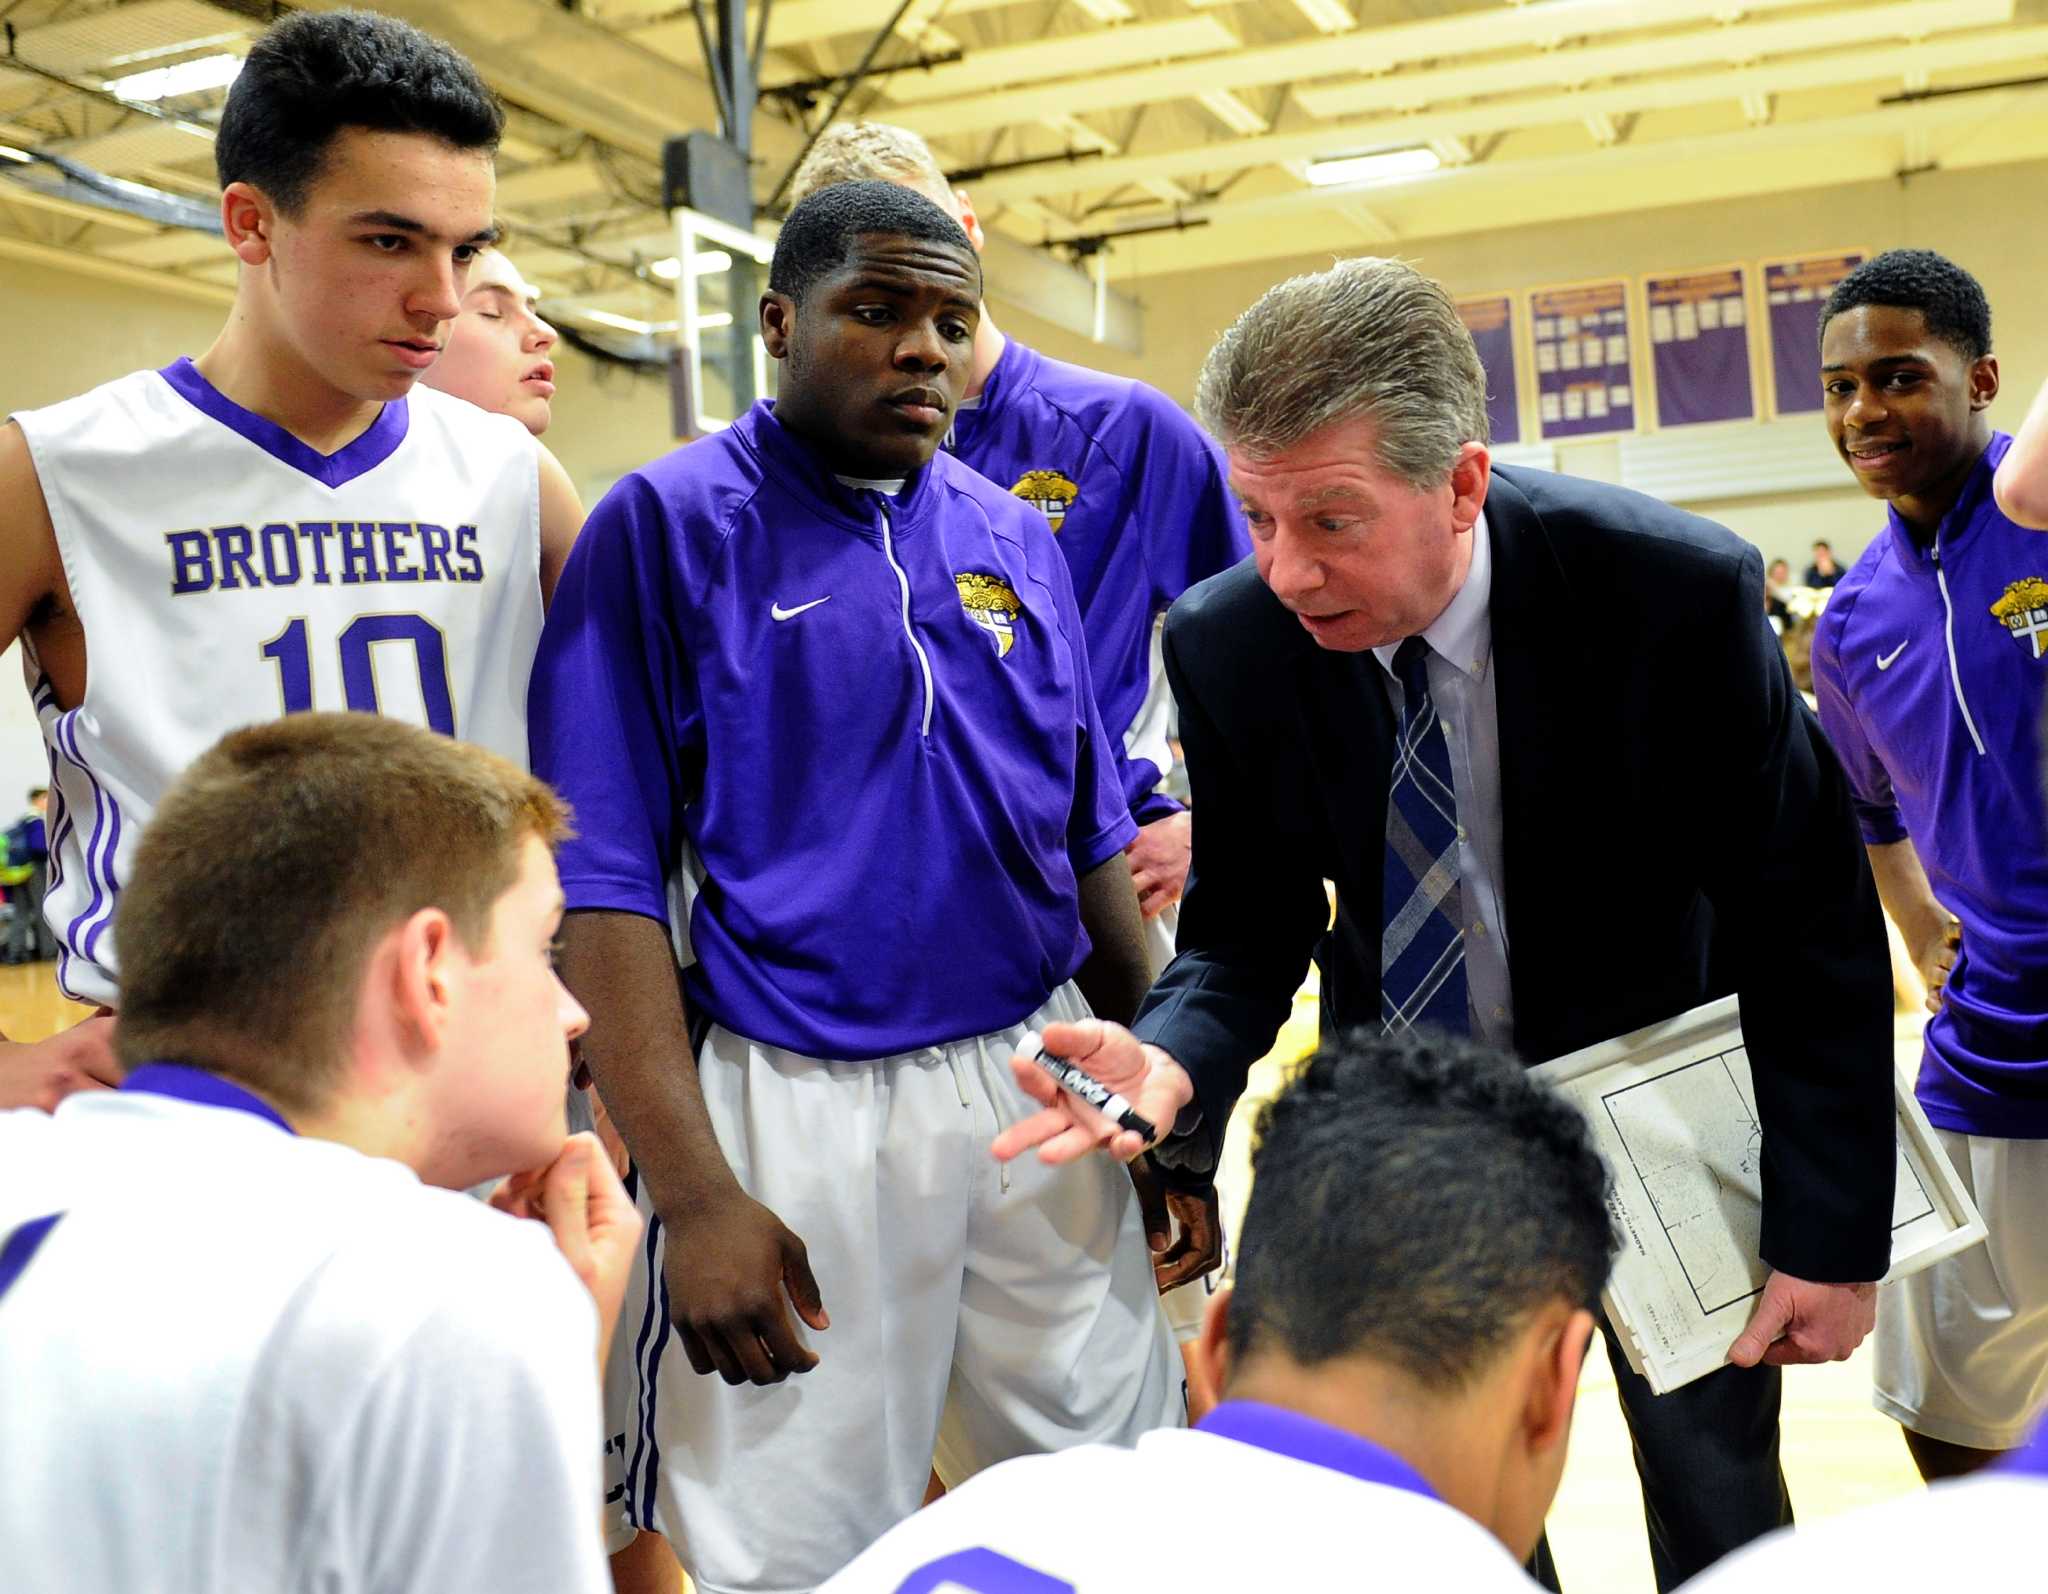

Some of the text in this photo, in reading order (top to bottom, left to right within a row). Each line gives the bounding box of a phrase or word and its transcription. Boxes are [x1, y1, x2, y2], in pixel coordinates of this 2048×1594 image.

[163, 520, 485, 596] BROTHERS
[258, 610, 458, 741] 10
[1625, 1216, 1646, 1256] MAGNETIC
